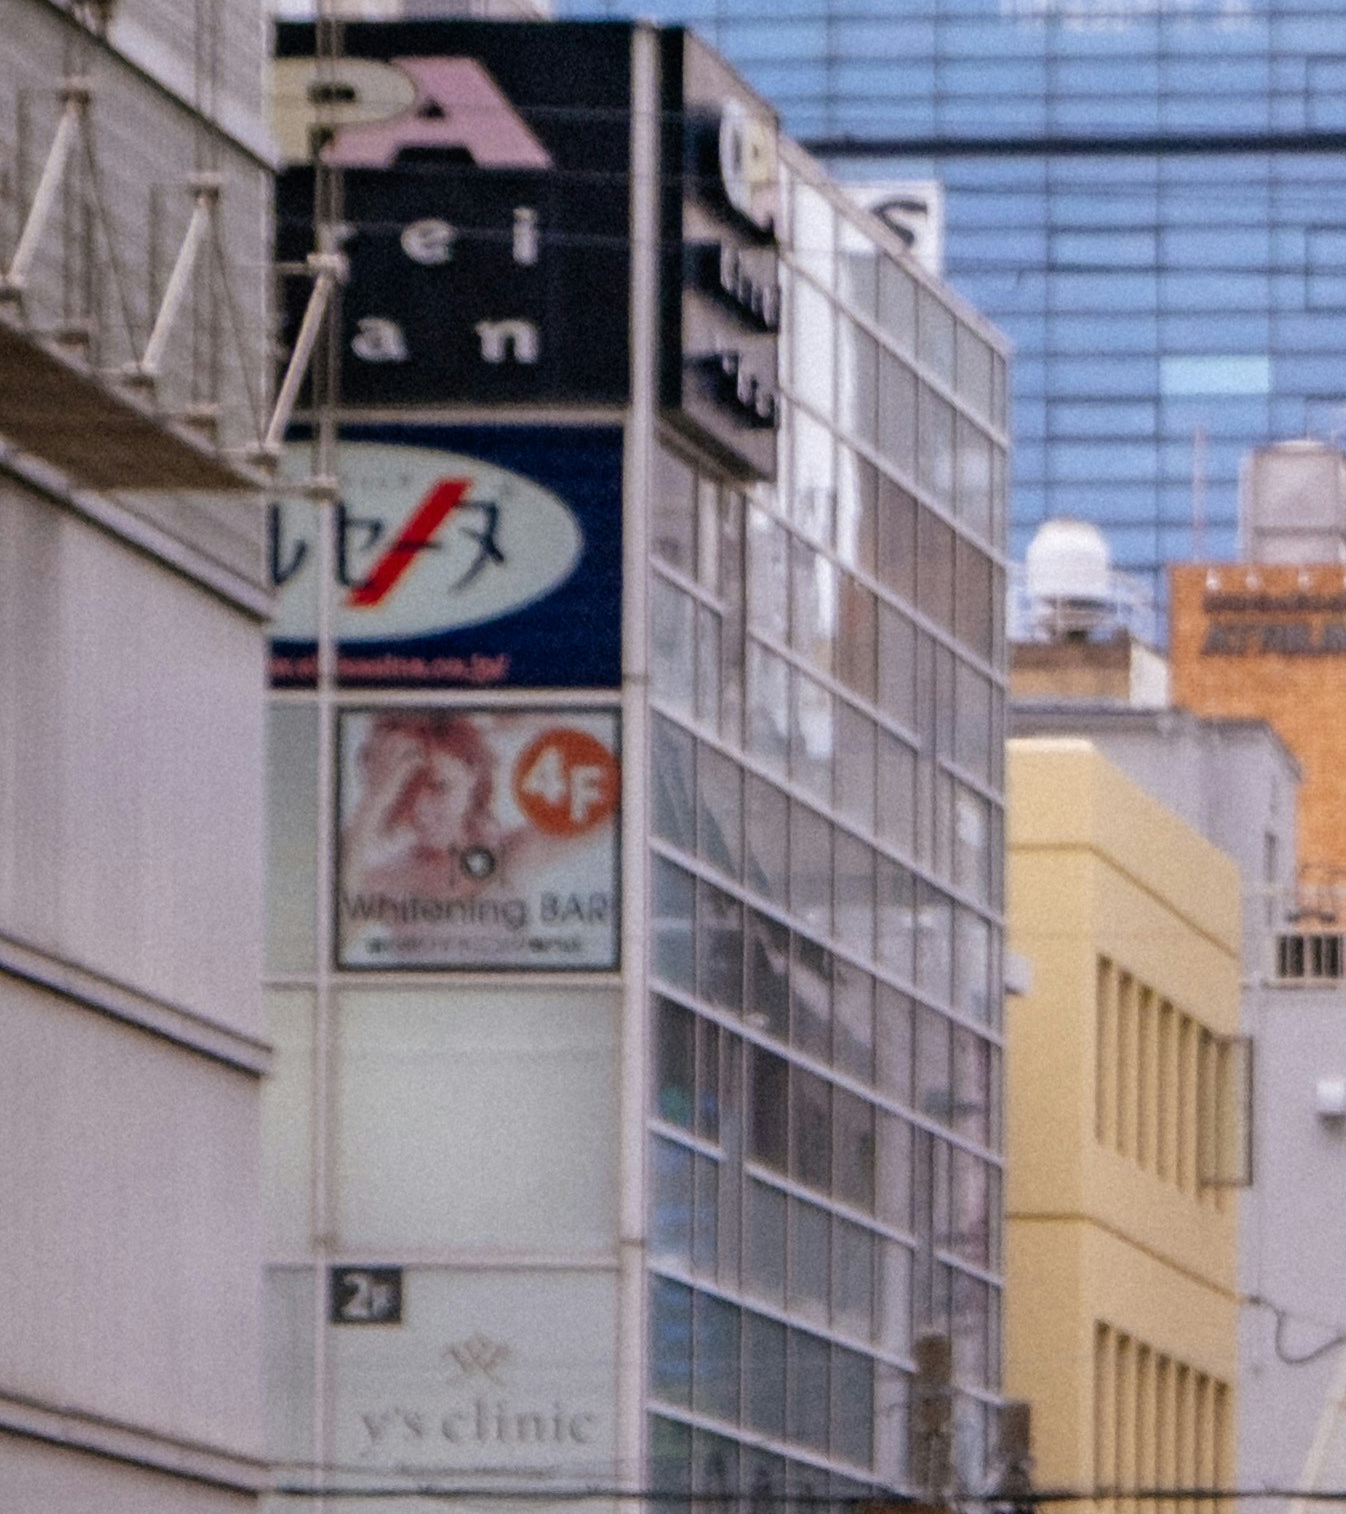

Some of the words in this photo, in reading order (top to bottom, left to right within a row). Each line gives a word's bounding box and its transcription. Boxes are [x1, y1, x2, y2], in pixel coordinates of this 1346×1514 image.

[521, 748, 602, 822] 4F
[540, 891, 610, 924] BAR
[440, 1397, 597, 1444] clinic
